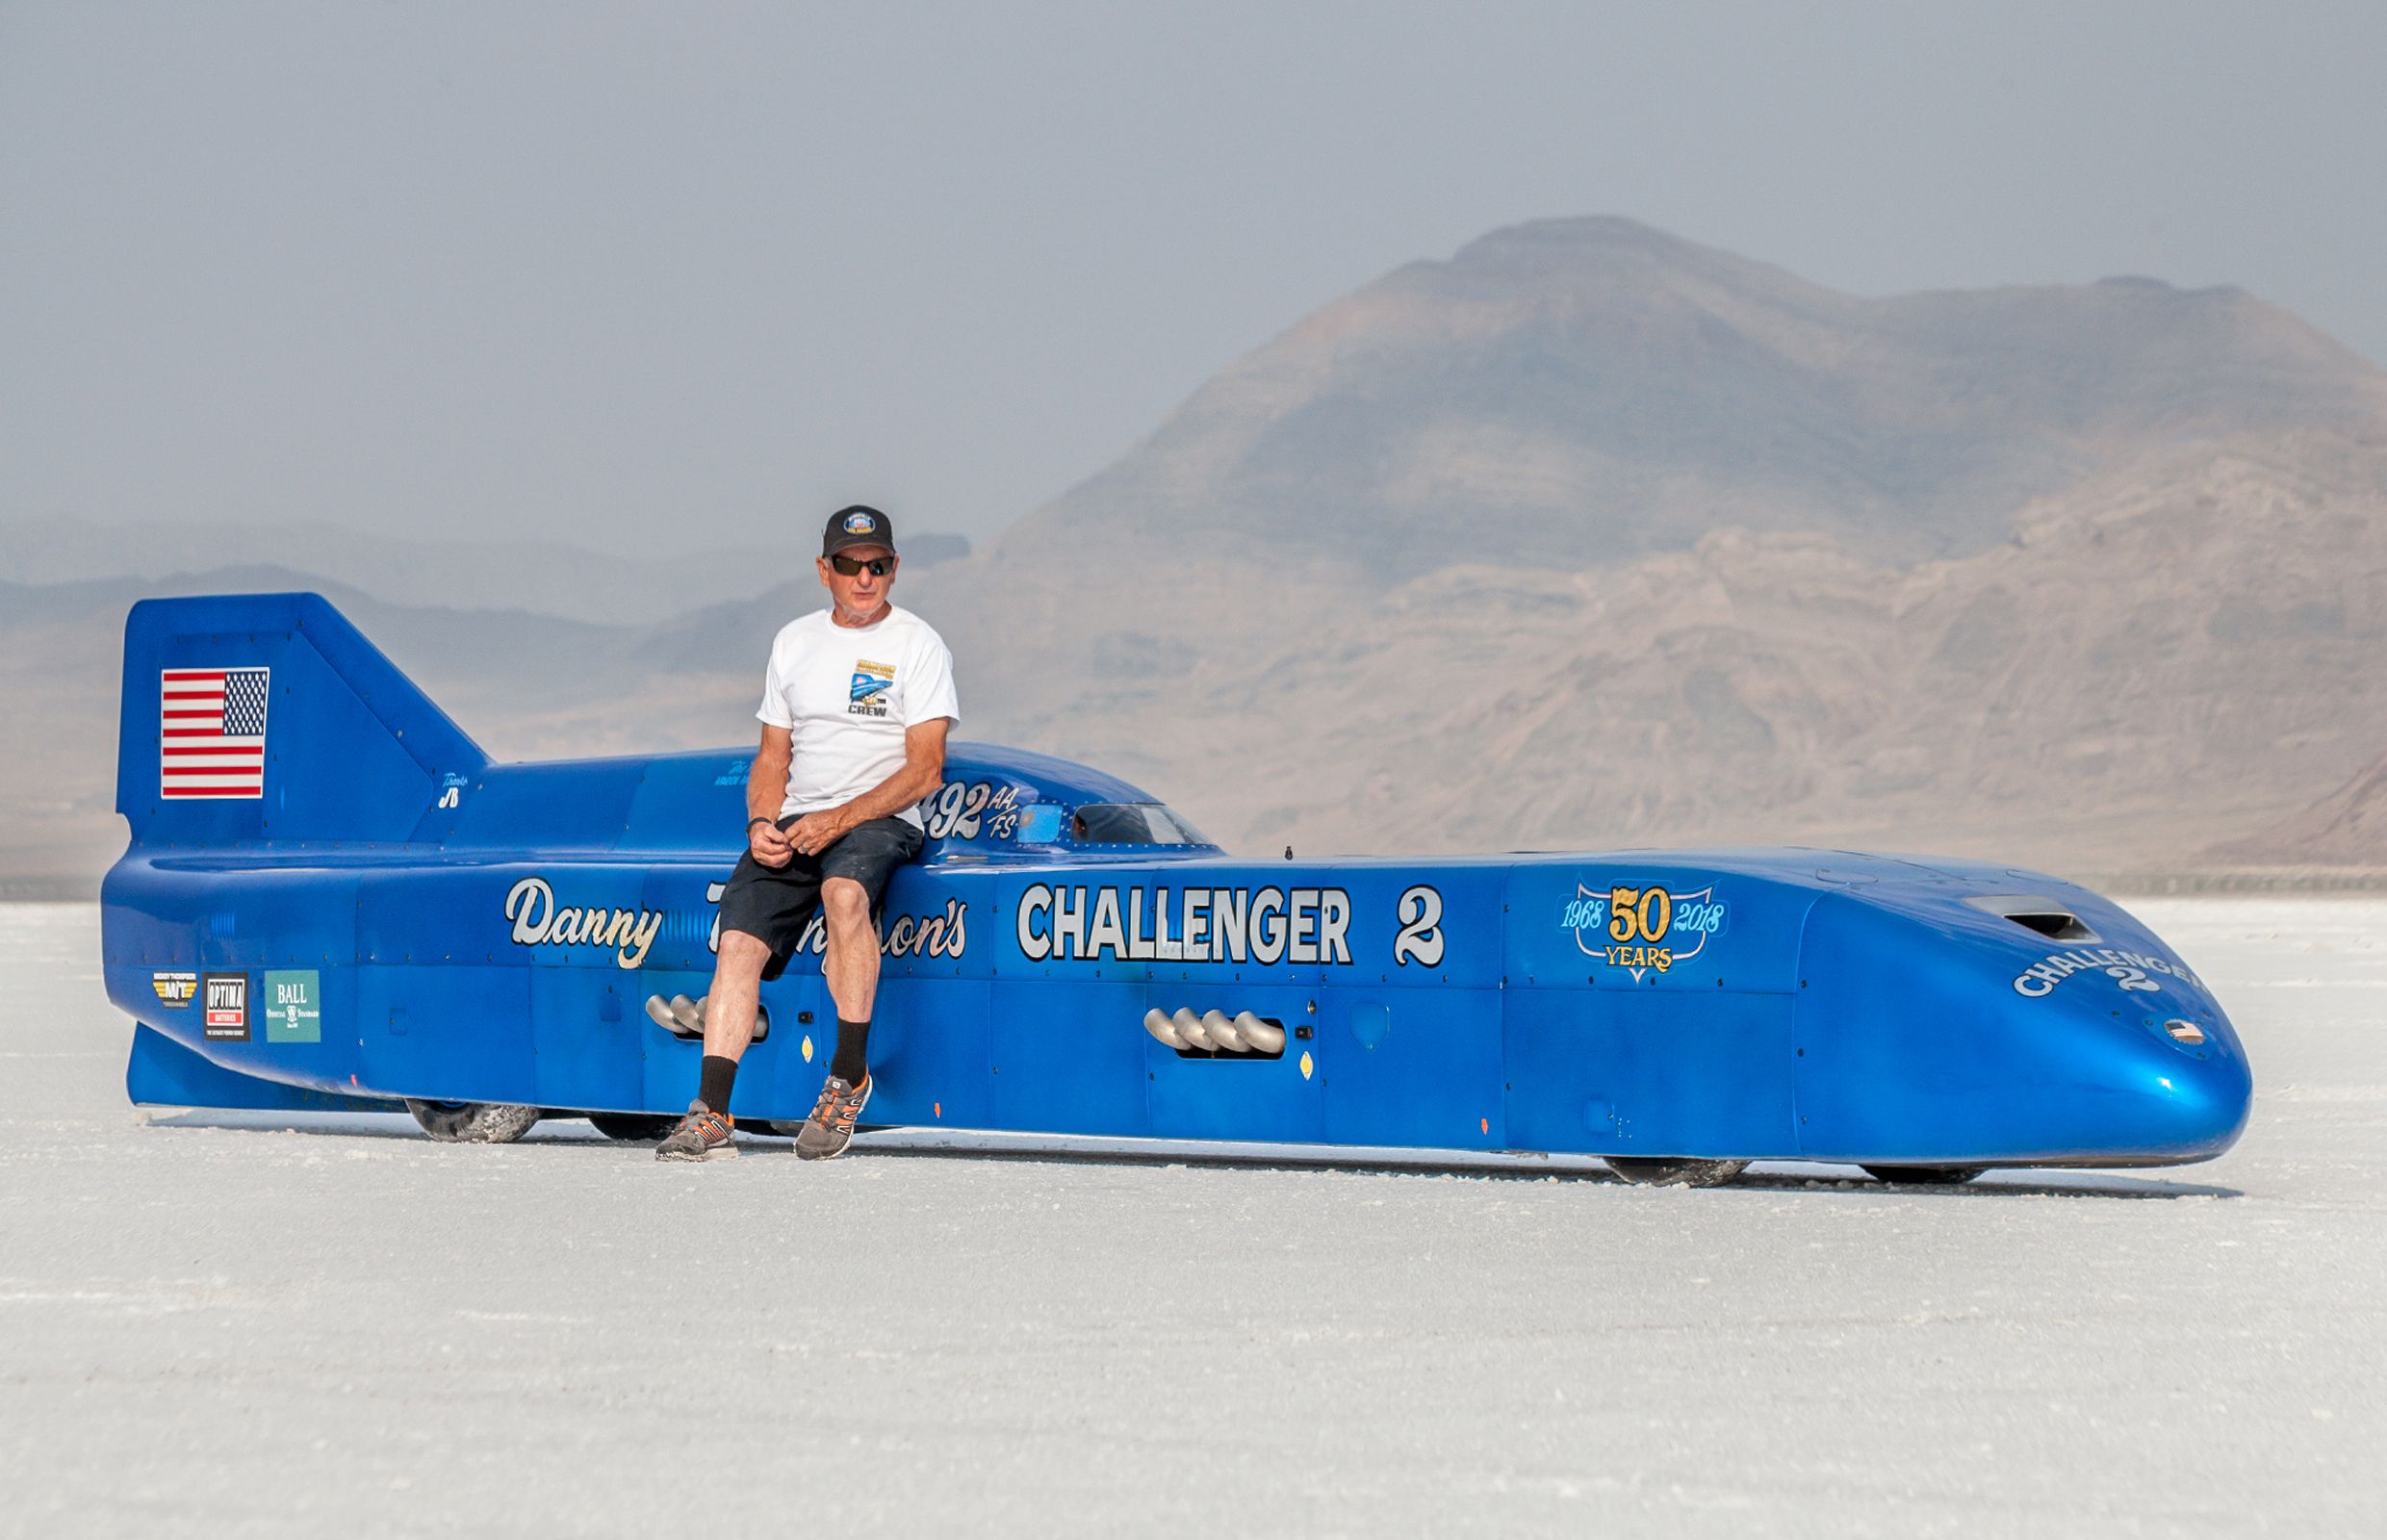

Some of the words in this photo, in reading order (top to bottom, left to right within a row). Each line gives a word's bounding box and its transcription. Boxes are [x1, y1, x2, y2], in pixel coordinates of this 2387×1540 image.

[848, 705, 886, 717] CREW
[505, 877, 662, 969] Danny
[706, 883, 967, 975] Tmson's
[1016, 883, 1352, 964] CHALLENGER
[1394, 885, 1445, 965] 2
[1561, 900, 1604, 929] 1968
[1608, 886, 1671, 942] 50
[1674, 903, 1724, 933] 2018
[1604, 945, 1673, 973] YEARS
[165, 980, 187, 999] M/T
[2105, 966, 2162, 992] 2
[209, 984, 243, 1008] OPTIMA
[277, 984, 307, 1004] BALL
